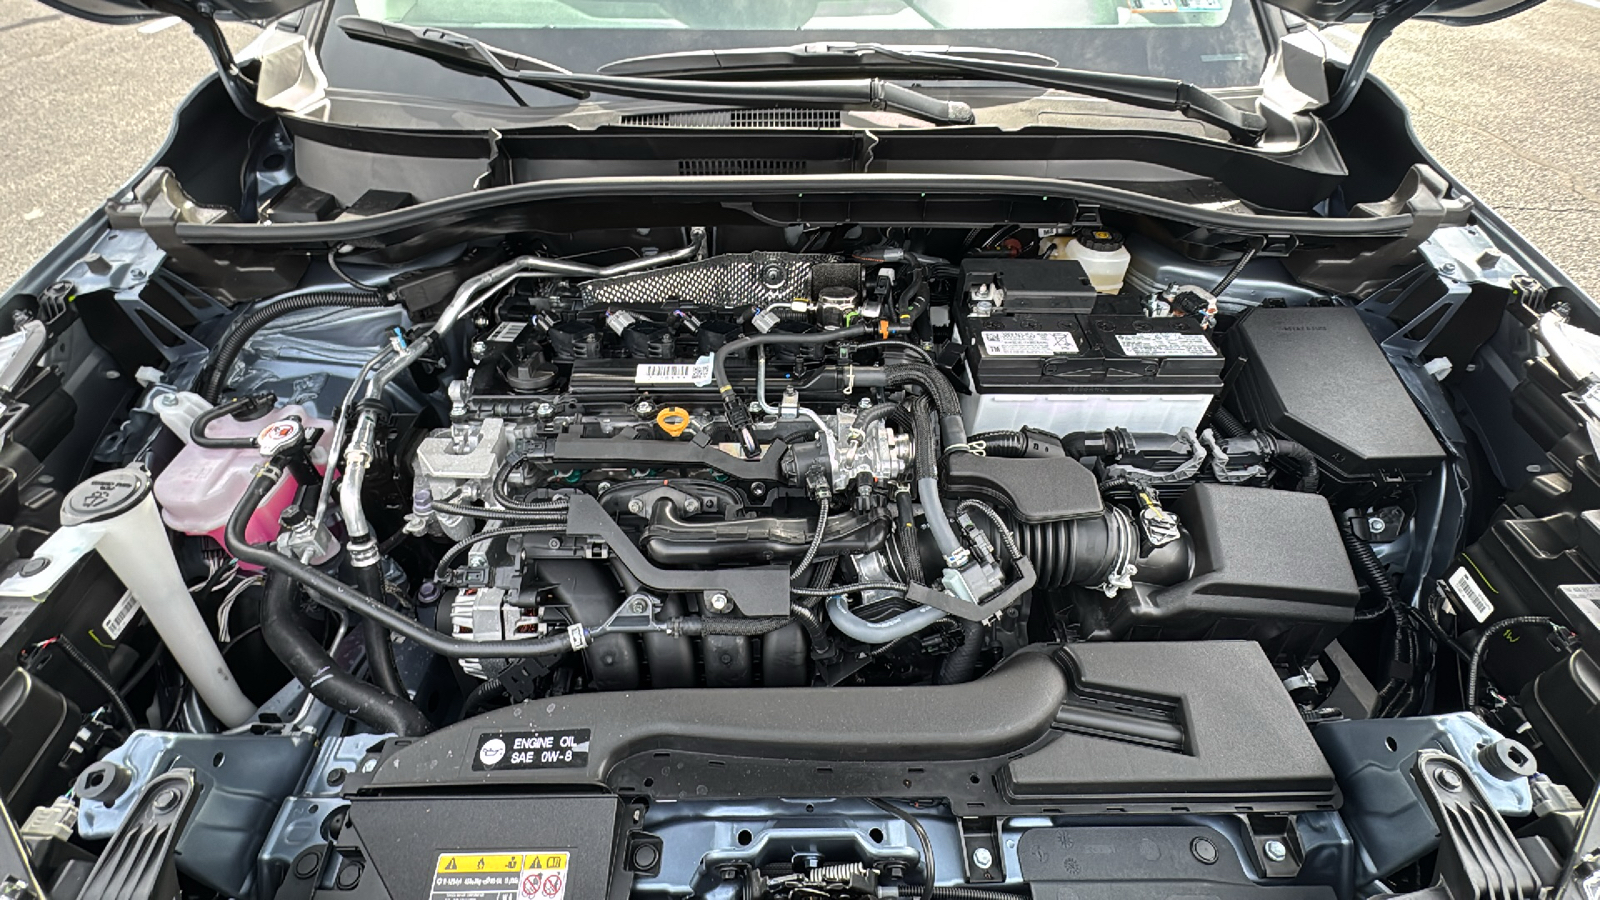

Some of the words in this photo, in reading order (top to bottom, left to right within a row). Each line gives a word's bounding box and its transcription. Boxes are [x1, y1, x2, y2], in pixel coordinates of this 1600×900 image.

[513, 737, 554, 749] ENGINE
[559, 736, 577, 748] OIL
[511, 751, 533, 763] SAE
[541, 750, 573, 763] 0W-8
